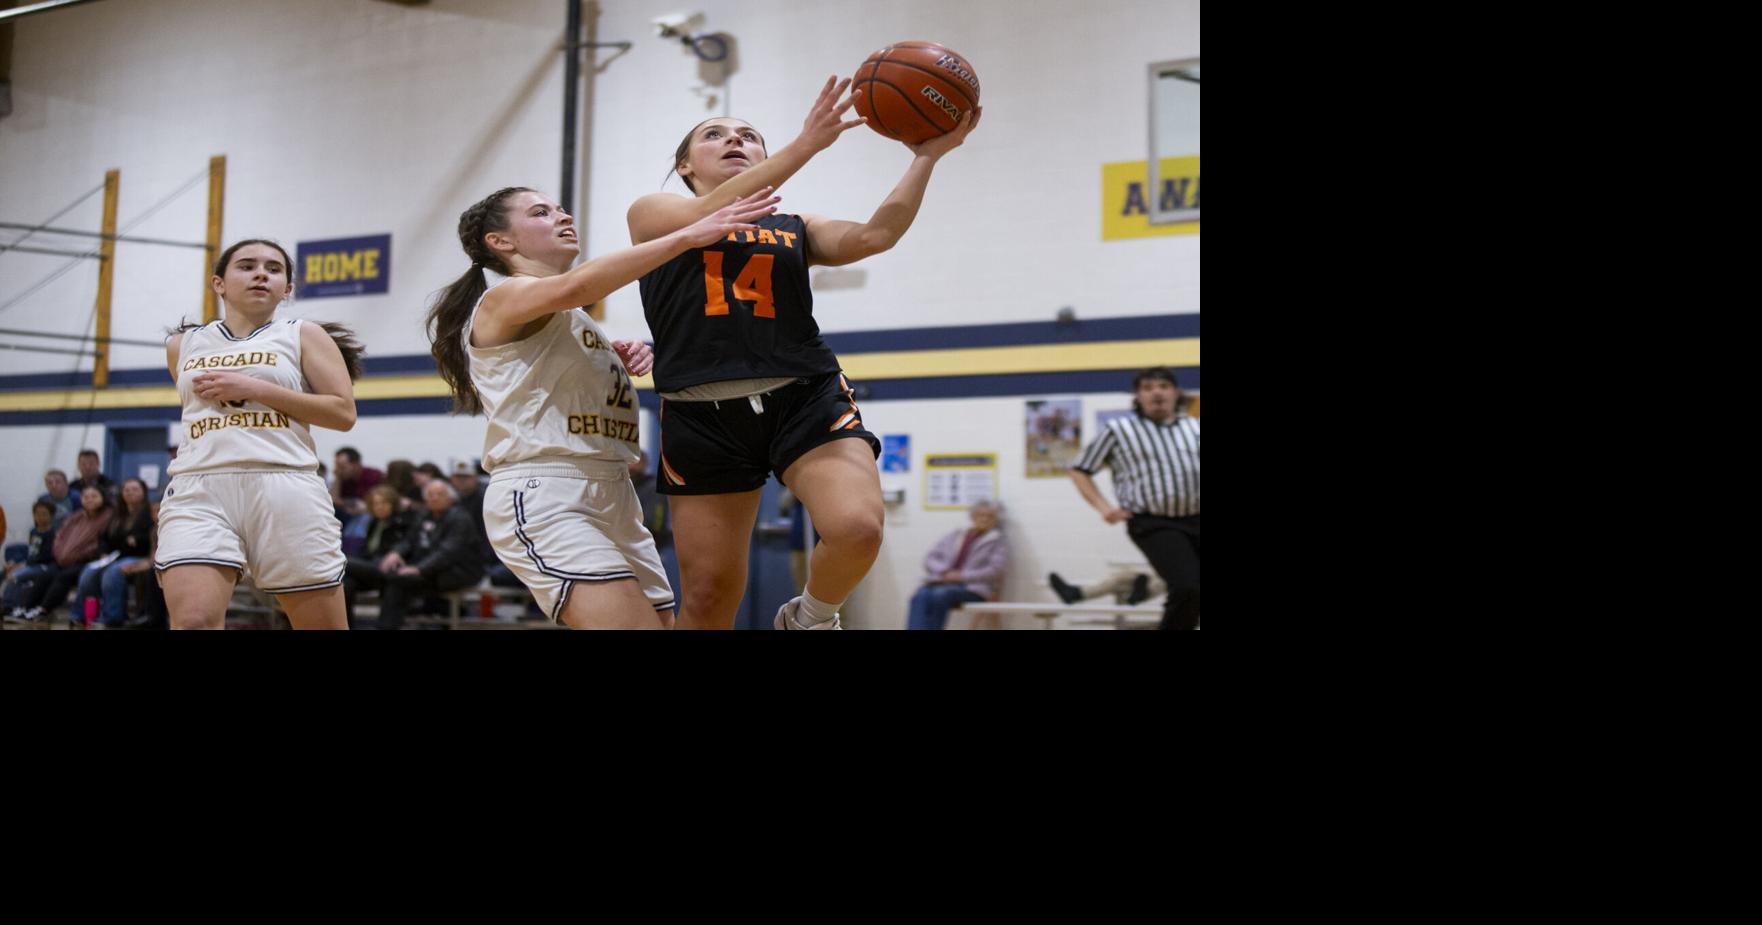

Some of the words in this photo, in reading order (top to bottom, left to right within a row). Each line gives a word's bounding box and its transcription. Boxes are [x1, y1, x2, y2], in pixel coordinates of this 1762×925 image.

[1121, 177, 1200, 216] AW
[305, 249, 380, 284] HOME
[703, 250, 776, 319] 14
[184, 352, 278, 372] CASCADE
[606, 363, 633, 409] 32
[190, 411, 290, 440] CHRISTIAN
